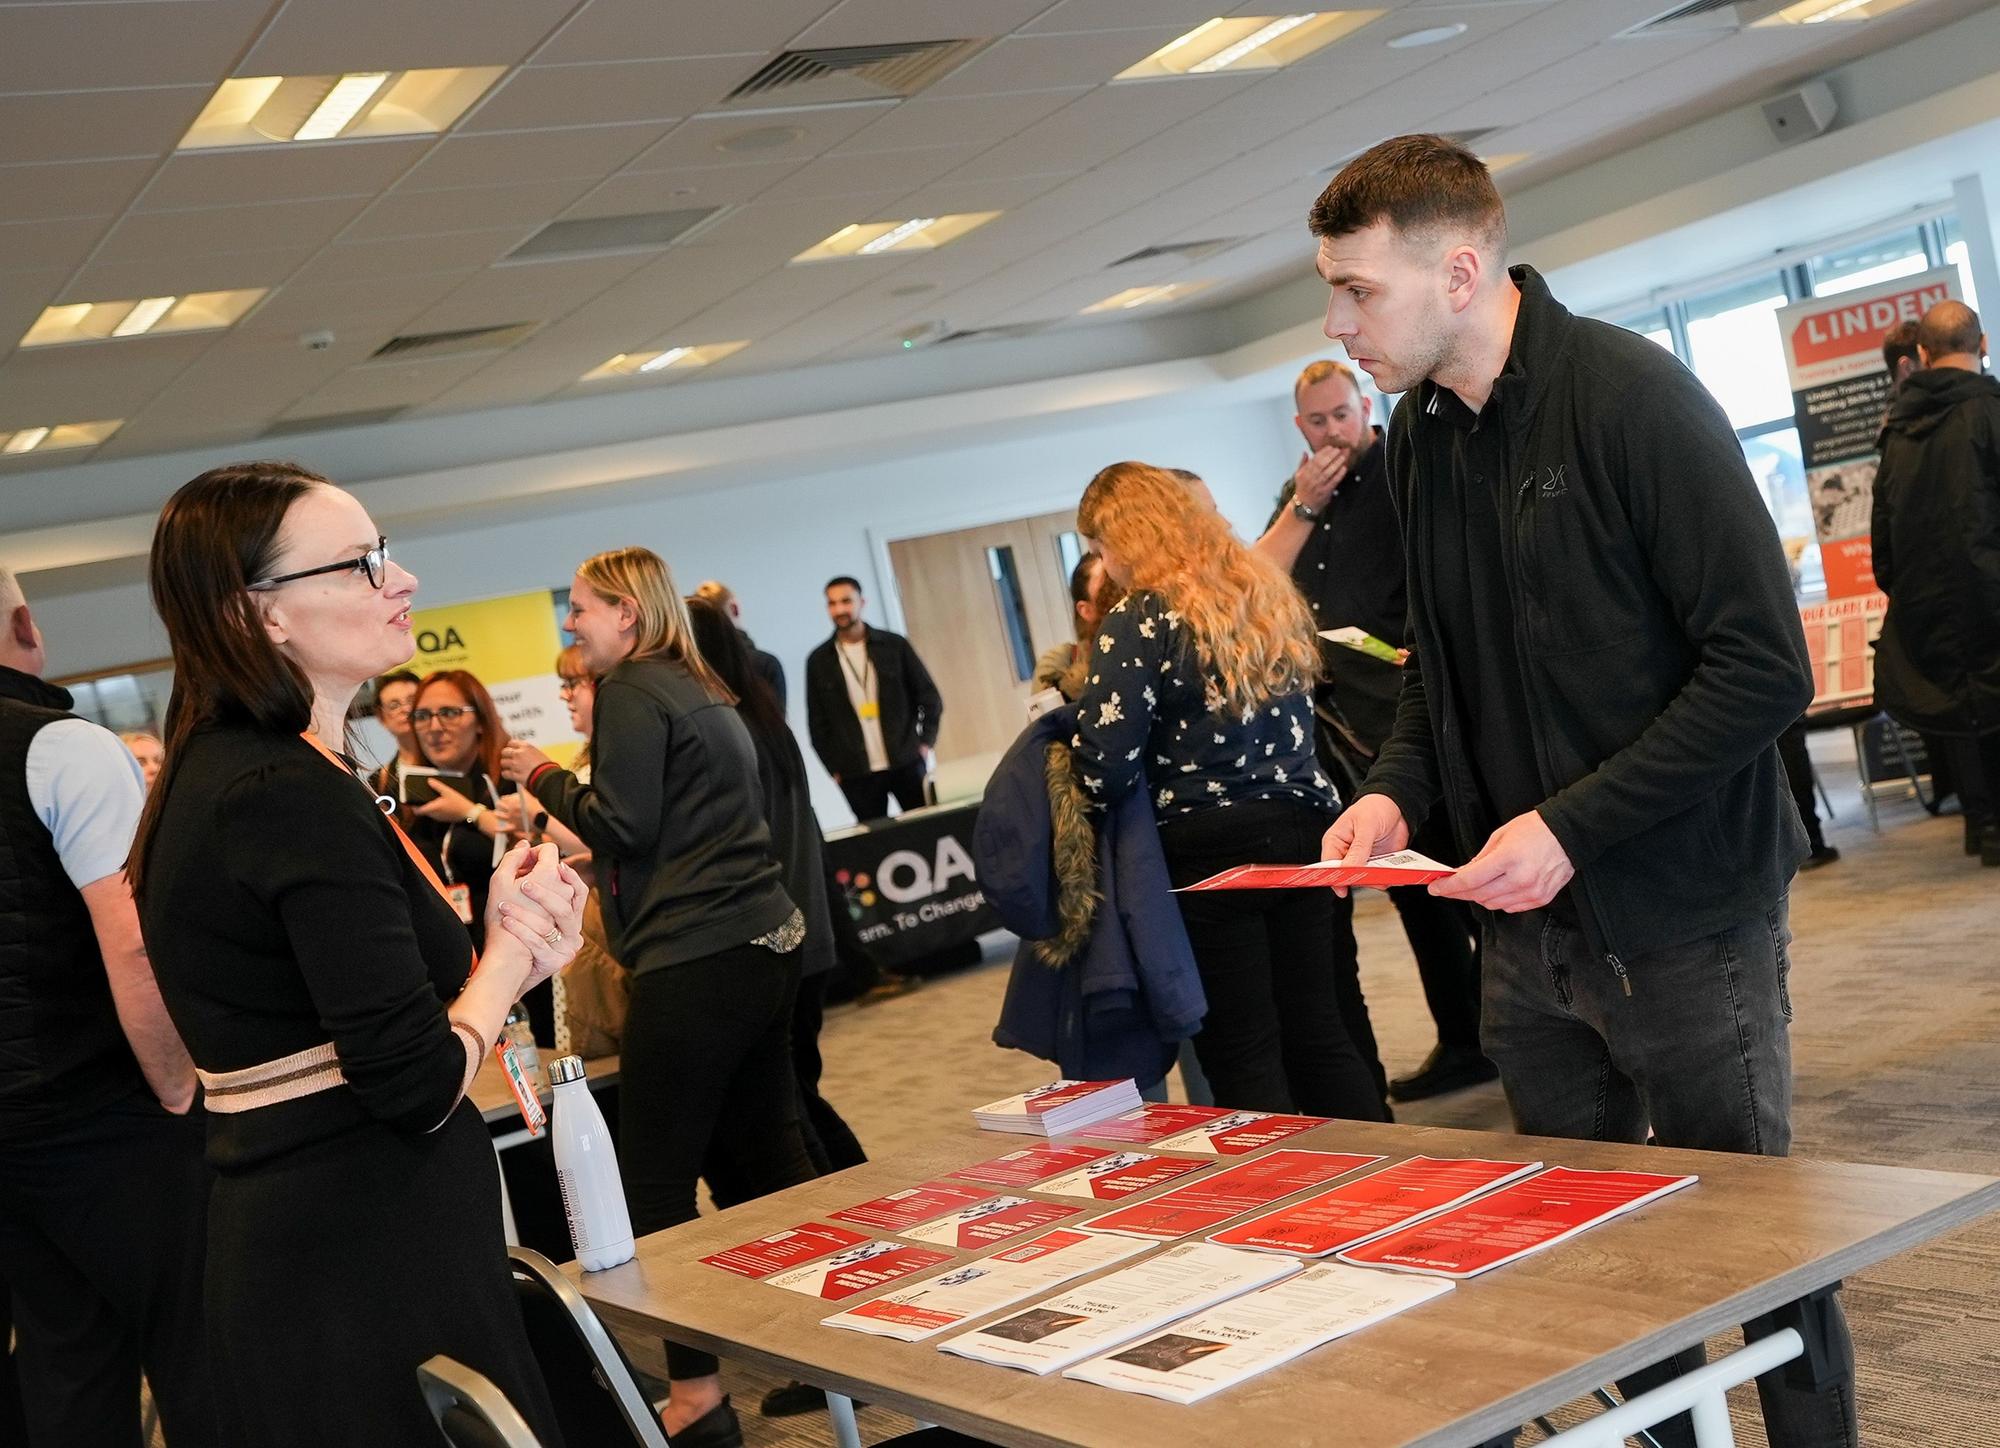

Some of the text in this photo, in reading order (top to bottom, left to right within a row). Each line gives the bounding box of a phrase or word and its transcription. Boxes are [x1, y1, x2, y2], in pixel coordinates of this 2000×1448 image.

[1806, 287, 1945, 345] LINDEN
[417, 628, 466, 654] QA
[876, 834, 976, 904] QA
[857, 922, 894, 944] arn.
[893, 912, 919, 931] To
